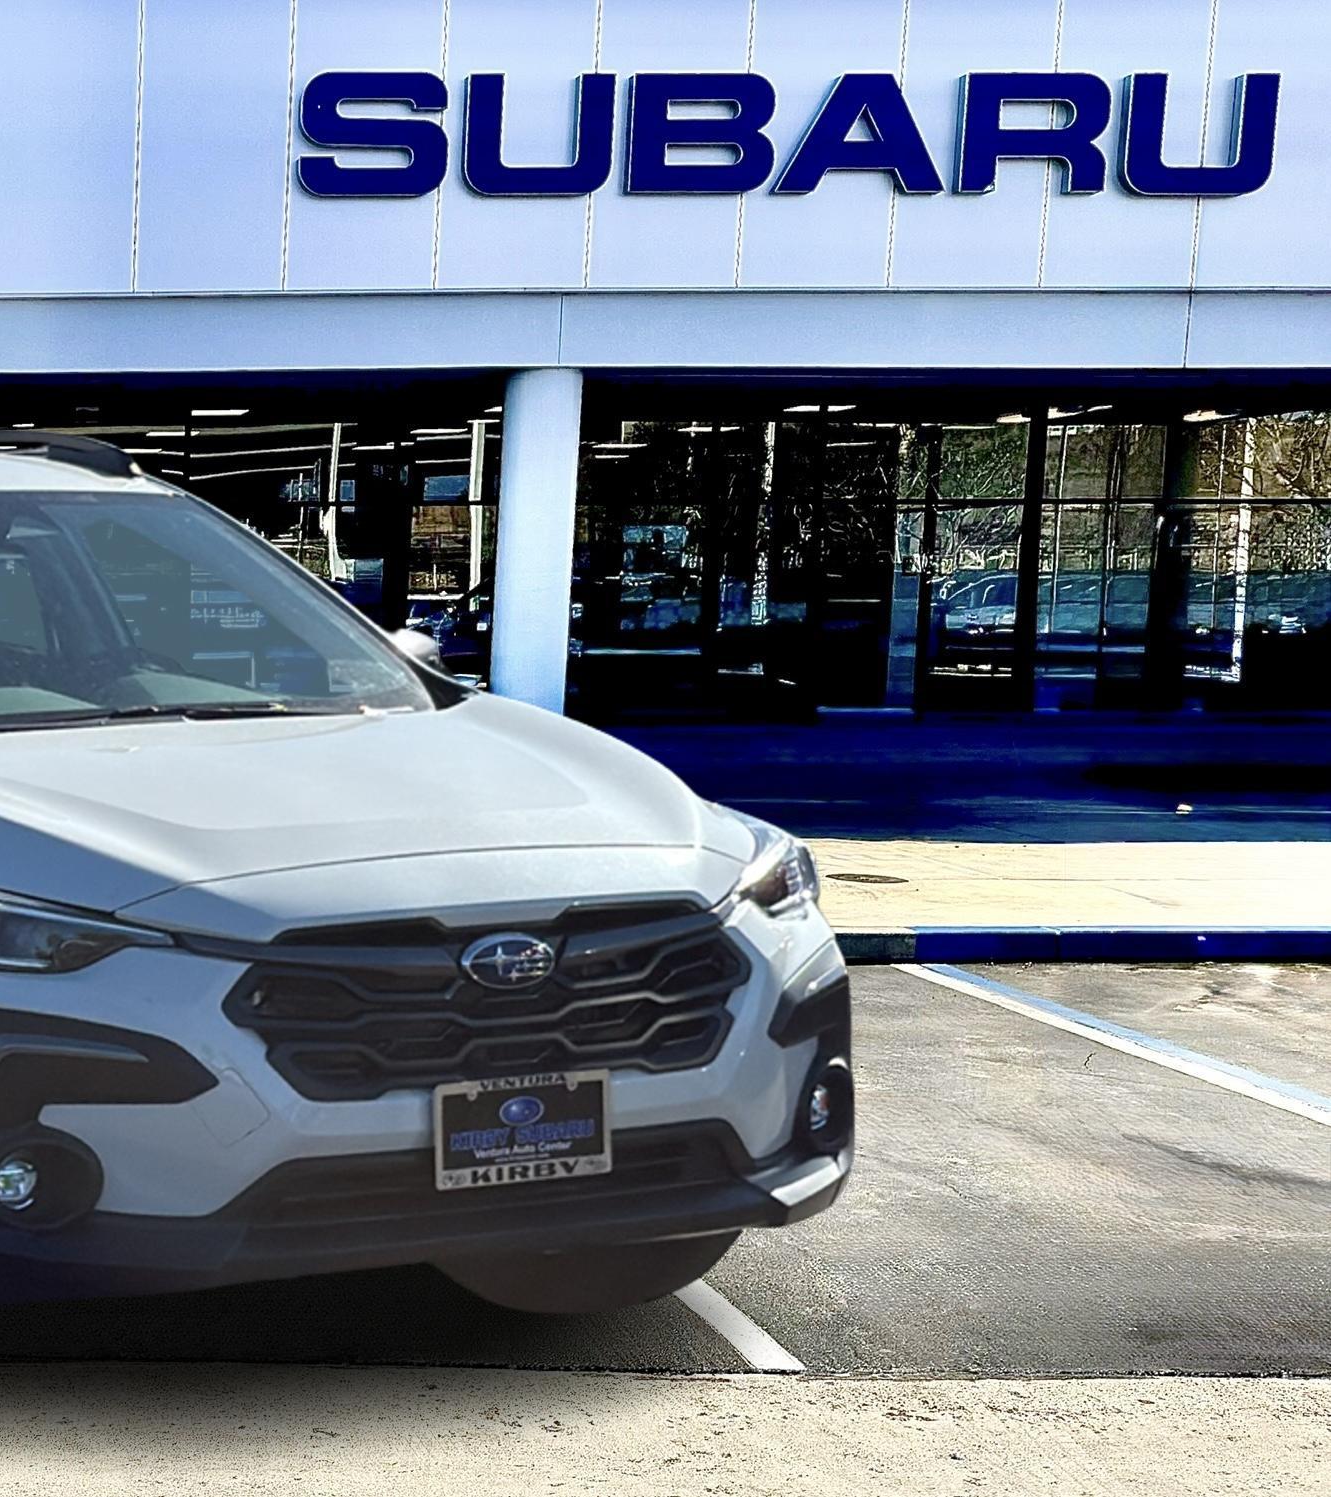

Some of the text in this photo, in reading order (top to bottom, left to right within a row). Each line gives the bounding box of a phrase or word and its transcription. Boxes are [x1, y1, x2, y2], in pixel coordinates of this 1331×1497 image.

[297, 70, 1283, 197] SUBARU
[480, 1073, 566, 1091] VENTURA
[450, 1118, 595, 1151] KIRBY SUBARU
[473, 1147, 510, 1159] Ventura
[512, 1144, 536, 1154] Auto
[538, 1141, 573, 1152] Center
[471, 1158, 580, 1185] KIRBY
